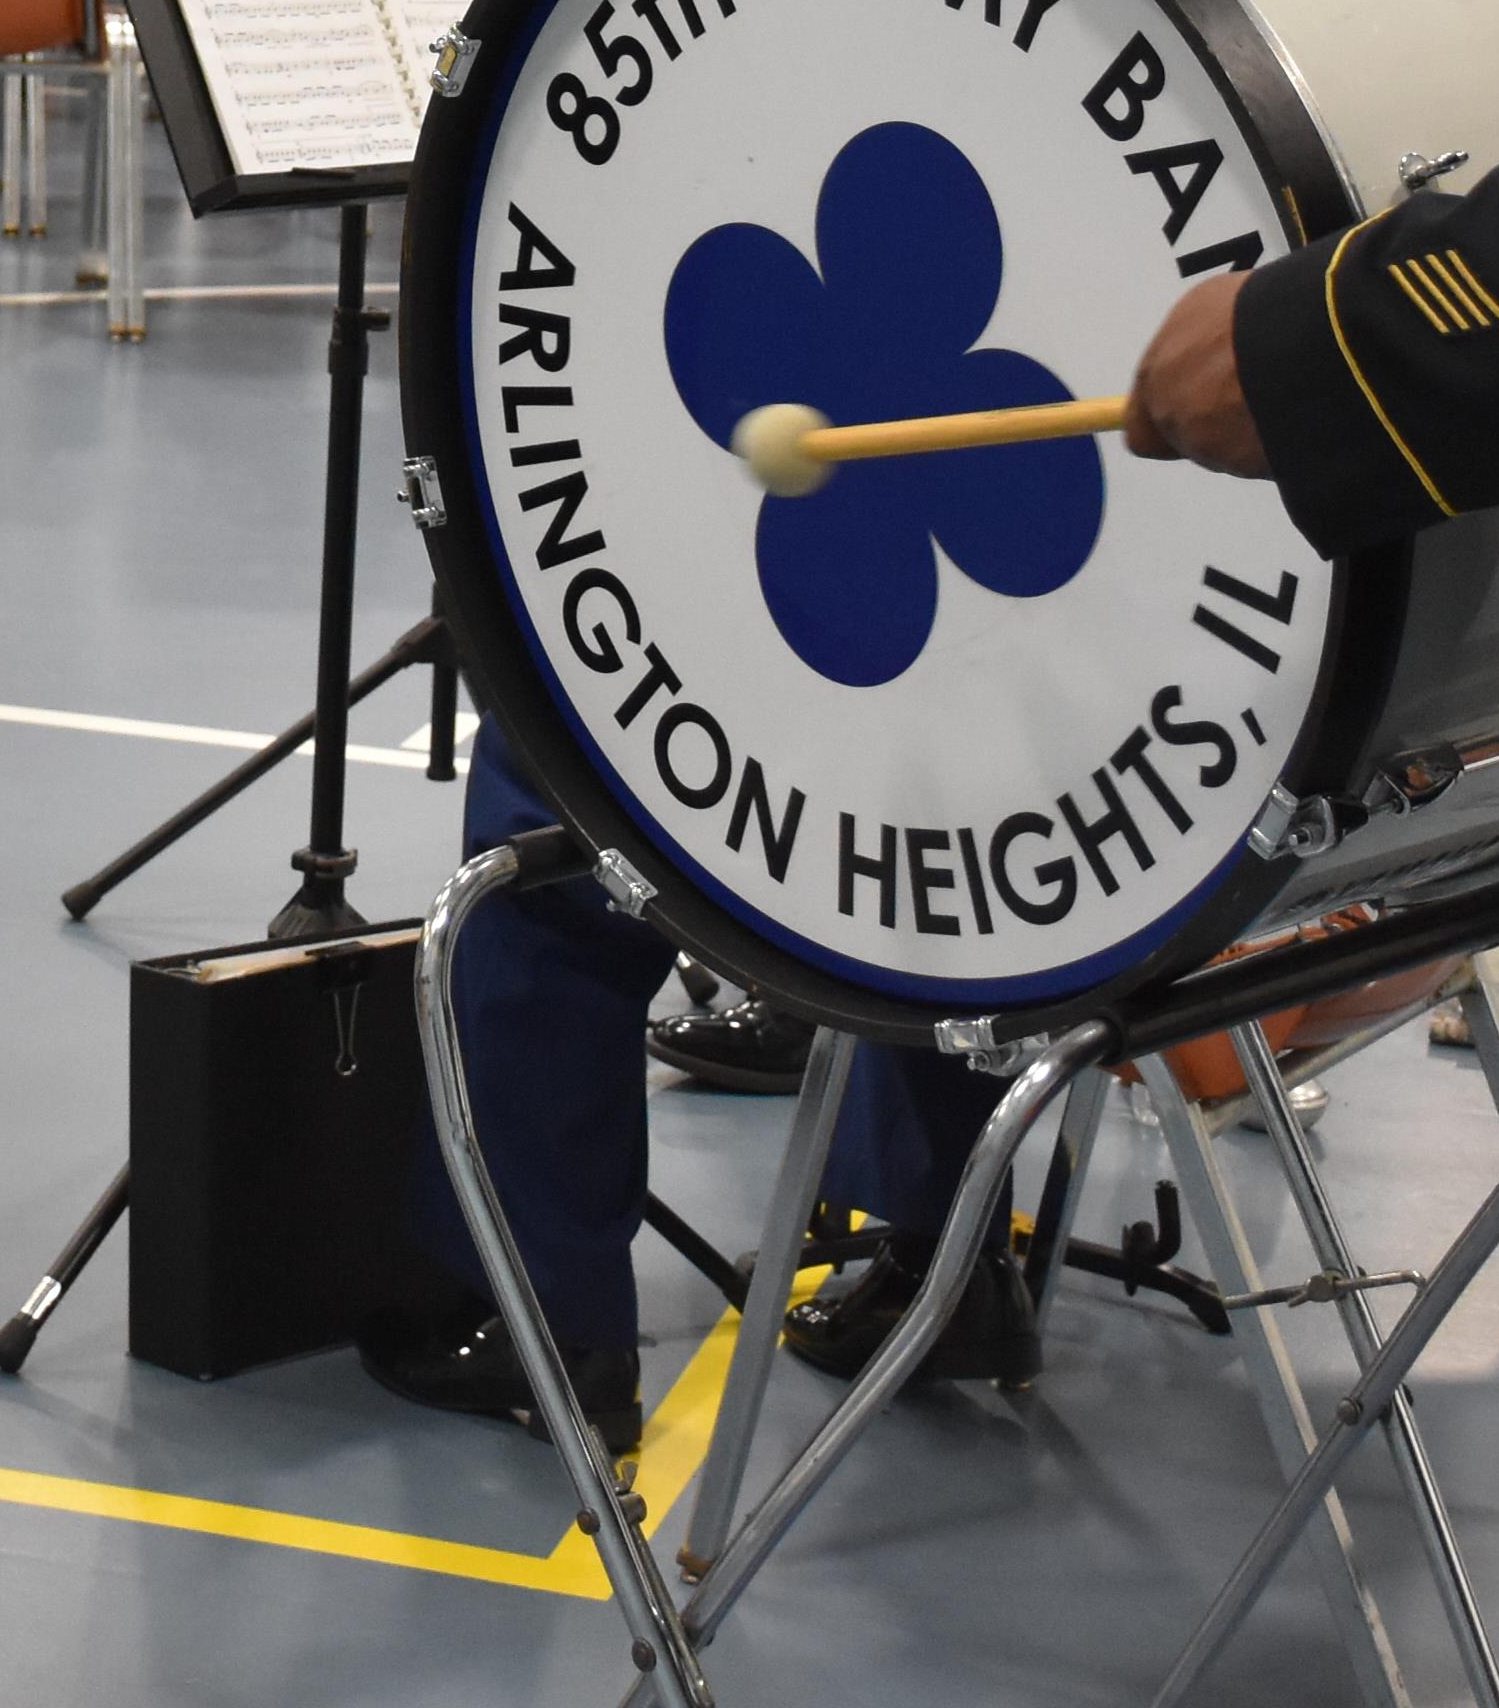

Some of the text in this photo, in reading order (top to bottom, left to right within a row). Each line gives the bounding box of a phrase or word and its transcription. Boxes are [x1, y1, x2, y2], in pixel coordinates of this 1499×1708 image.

[1081, 30, 1265, 279] BA
[498, 201, 1299, 937] ARLINGTON HEIGHTS, IL
